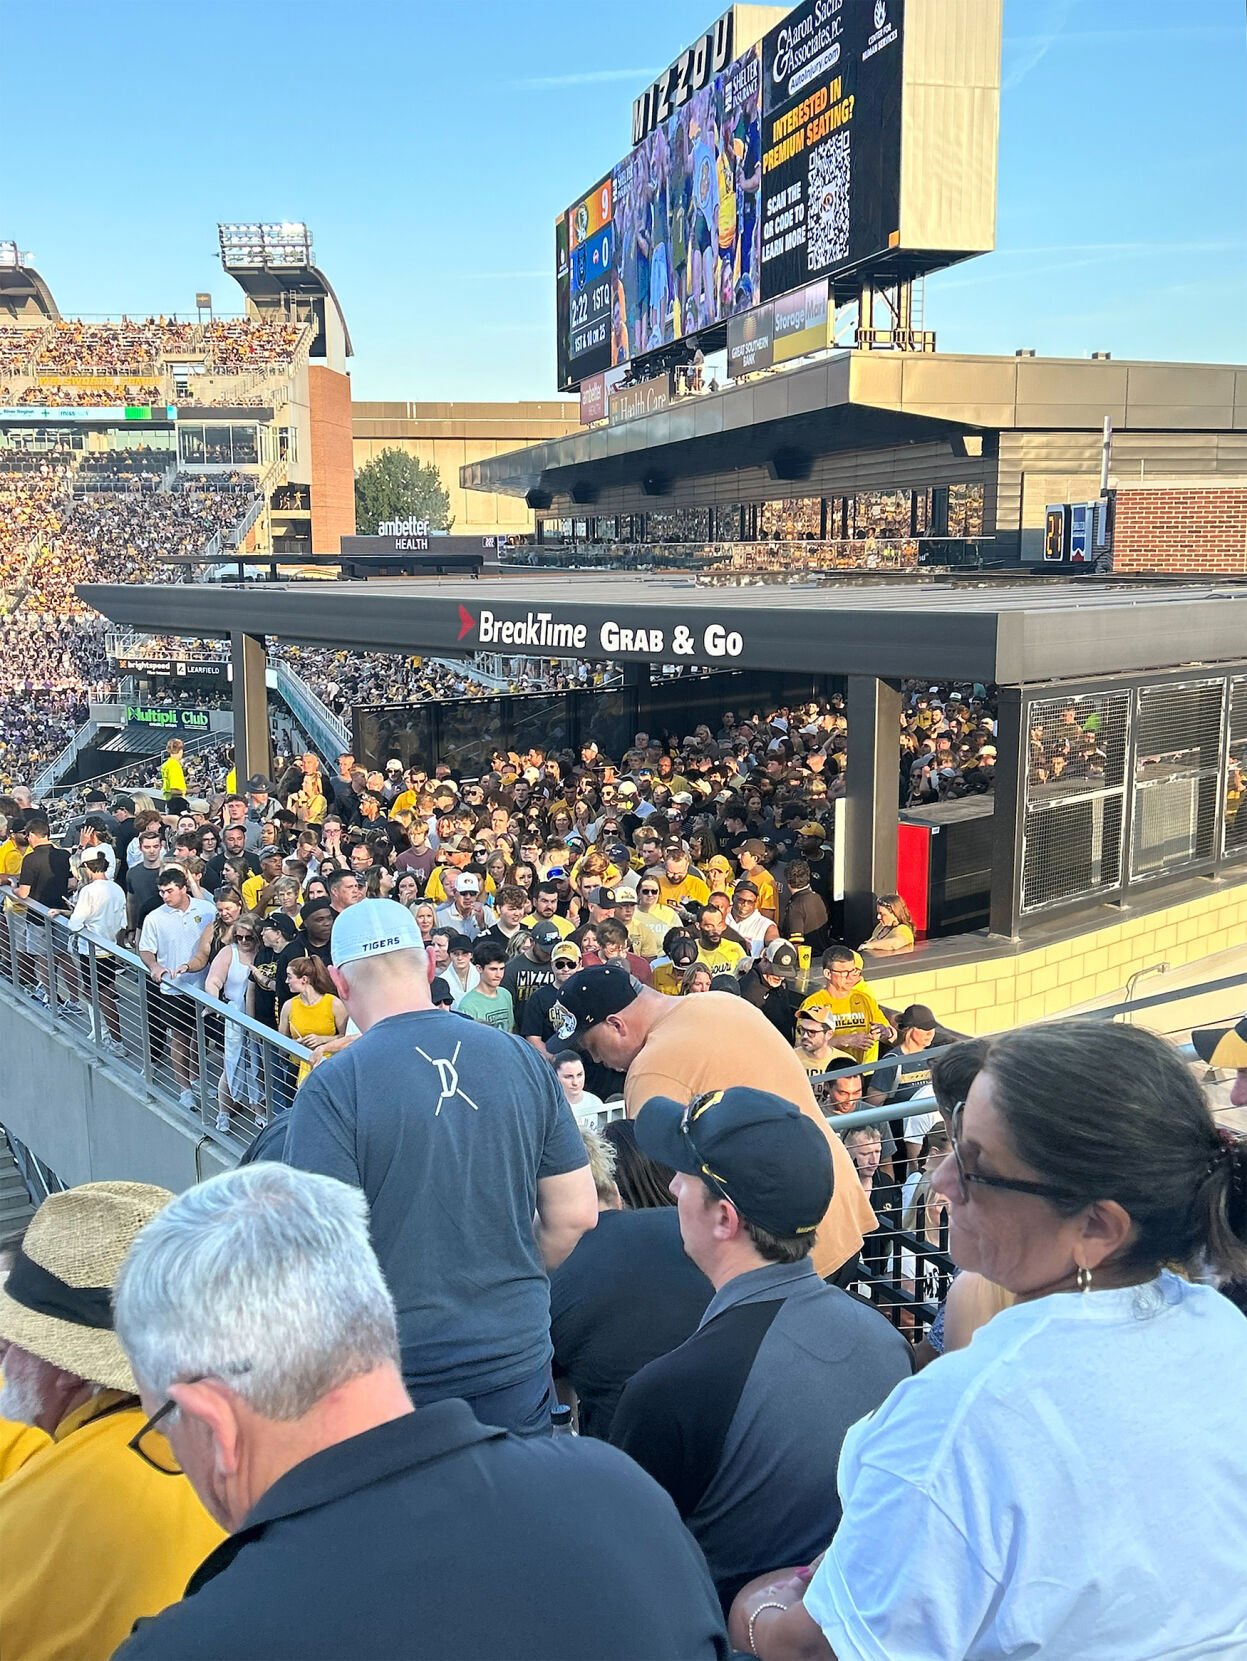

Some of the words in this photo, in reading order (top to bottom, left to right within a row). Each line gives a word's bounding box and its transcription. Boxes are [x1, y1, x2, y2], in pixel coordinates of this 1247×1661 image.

[787, 17, 813, 48] Aaron
[632, 12, 733, 146] MIZZOU
[733, 58, 758, 93] SHELTER
[772, 86, 827, 143] INTERESTED
[830, 75, 842, 104] IN
[762, 128, 805, 175] PREMIUM
[806, 94, 855, 146] SEATING?
[601, 188, 610, 219] 9
[767, 189, 786, 216] SCAN
[787, 181, 802, 204] THE
[775, 208, 794, 235] CODE
[795, 203, 805, 223] TO
[602, 236, 609, 268] 0
[761, 237, 784, 262] LEARN
[785, 225, 807, 252] MORE
[572, 293, 588, 328] 2:22
[620, 392, 645, 420] Health
[646, 388, 666, 413] Care
[378, 516, 430, 536] ambetter
[395, 538, 428, 550] HEALTH
[479, 610, 587, 648] BreakTime
[672, 625, 695, 655] &
[128, 661, 171, 671] brightspeed
[187, 666, 220, 674] LEARFIELD
[127, 706, 178, 726] Multipli
[181, 711, 208, 725] Club
[362, 936, 400, 952] TIGERS
